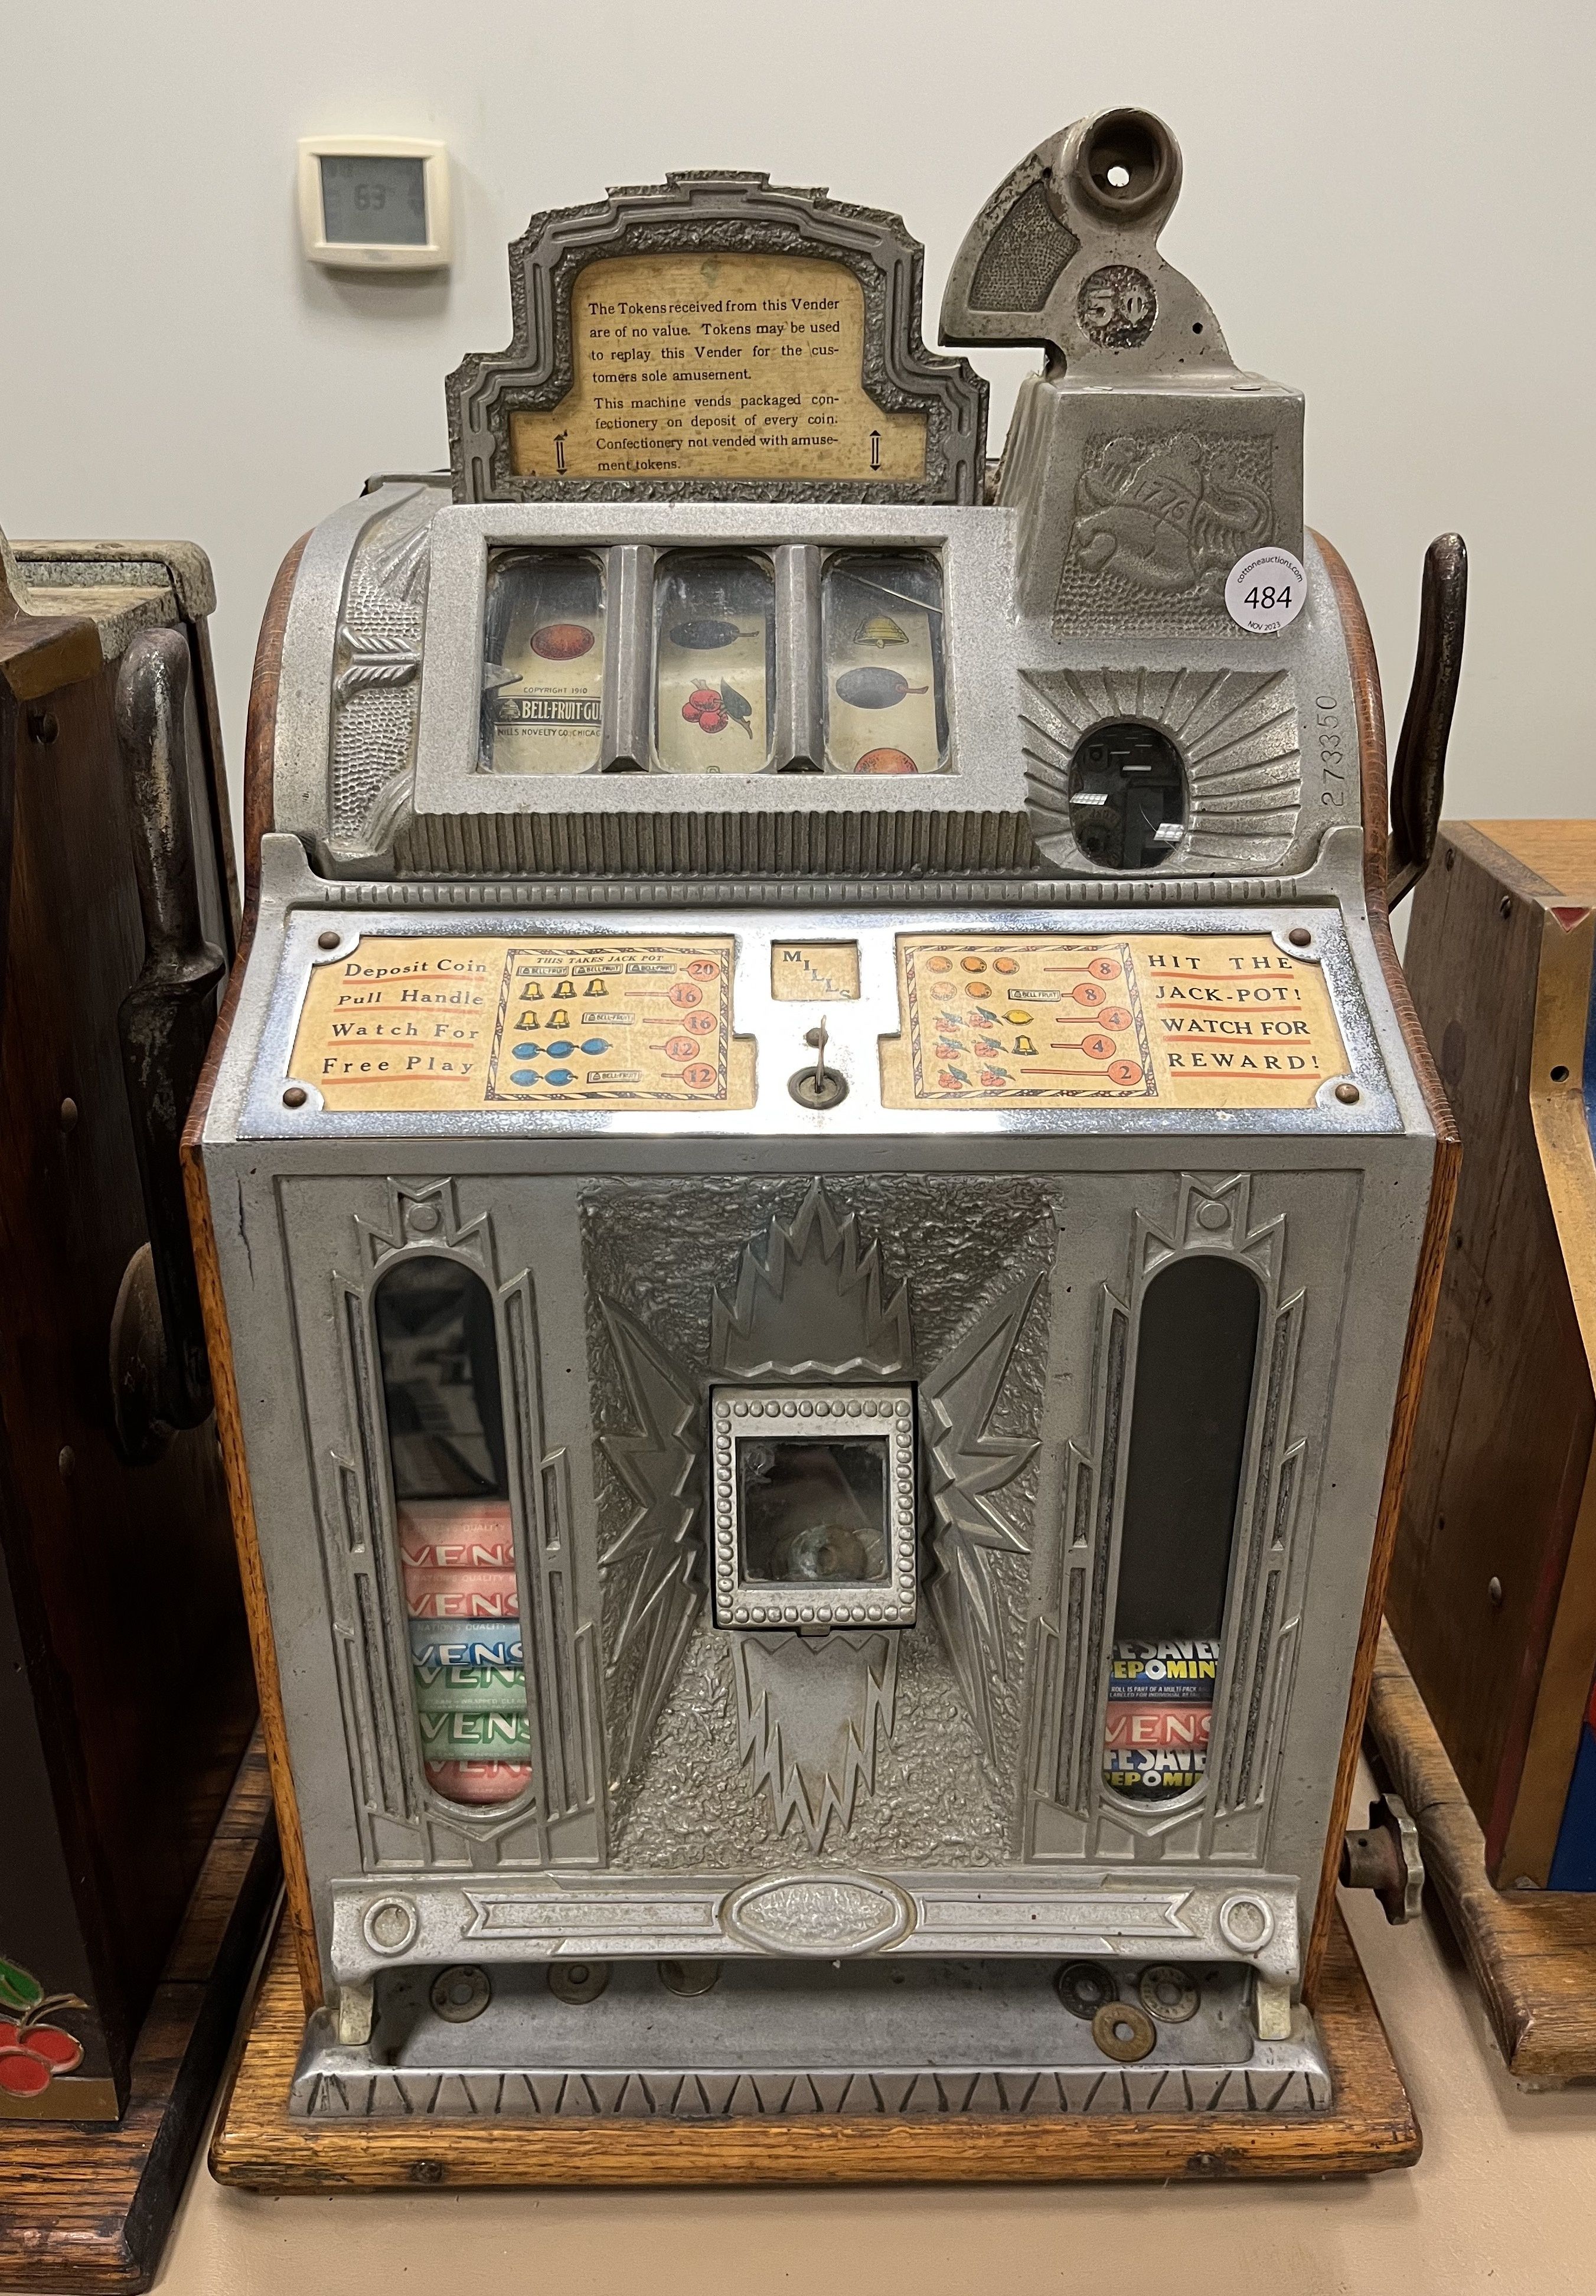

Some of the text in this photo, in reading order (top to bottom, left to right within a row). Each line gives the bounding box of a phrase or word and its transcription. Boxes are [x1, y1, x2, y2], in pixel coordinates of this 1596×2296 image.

[589, 298, 840, 315] The Tokens received from this Vender
[590, 321, 840, 338] are of no value. Tokens may be used
[592, 345, 839, 361] to replay this Vender for the cus-
[593, 369, 751, 383] tomers sole amusement.
[594, 395, 839, 410] This machine vends packaged con-
[596, 415, 838, 430] fectionery on deposit of every coin.
[596, 438, 683, 451] Confectionery
[712, 436, 756, 447] vended
[759, 435, 788, 446] with
[791, 436, 838, 445] amuse-
[598, 459, 680, 471] ment tokens.
[1238, 556, 1303, 583] cottoneauctions.com
[1244, 586, 1292, 609] 484
[1248, 621, 1281, 631] NOV 2023
[1316, 696, 1344, 806] 273350
[345, 959, 487, 979] Deposit Coin
[692, 963, 714, 976] 20
[1100, 963, 1111, 974] 8
[1148, 955, 1292, 969] HIT THE
[338, 990, 484, 1005] Pull Handle
[676, 989, 696, 1002] 16
[1086, 989, 1096, 1000] 8
[1156, 986, 1301, 1002] JACK-POT!
[690, 1017, 711, 1029] 16
[1108, 1013, 1120, 1025] 4
[332, 1022, 479, 1039] Watch For
[1161, 1019, 1310, 1035] WATCH FOR
[672, 1043, 693, 1055] 12
[1092, 1041, 1104, 1052] 4
[322, 1056, 474, 1074] Free Play
[1167, 1052, 1319, 1069] REWARD!
[688, 1069, 710, 1082] 12
[1121, 1065, 1132, 1079] 2
[401, 1544, 514, 1566] VEN
[418, 1666, 525, 1683] VEN
